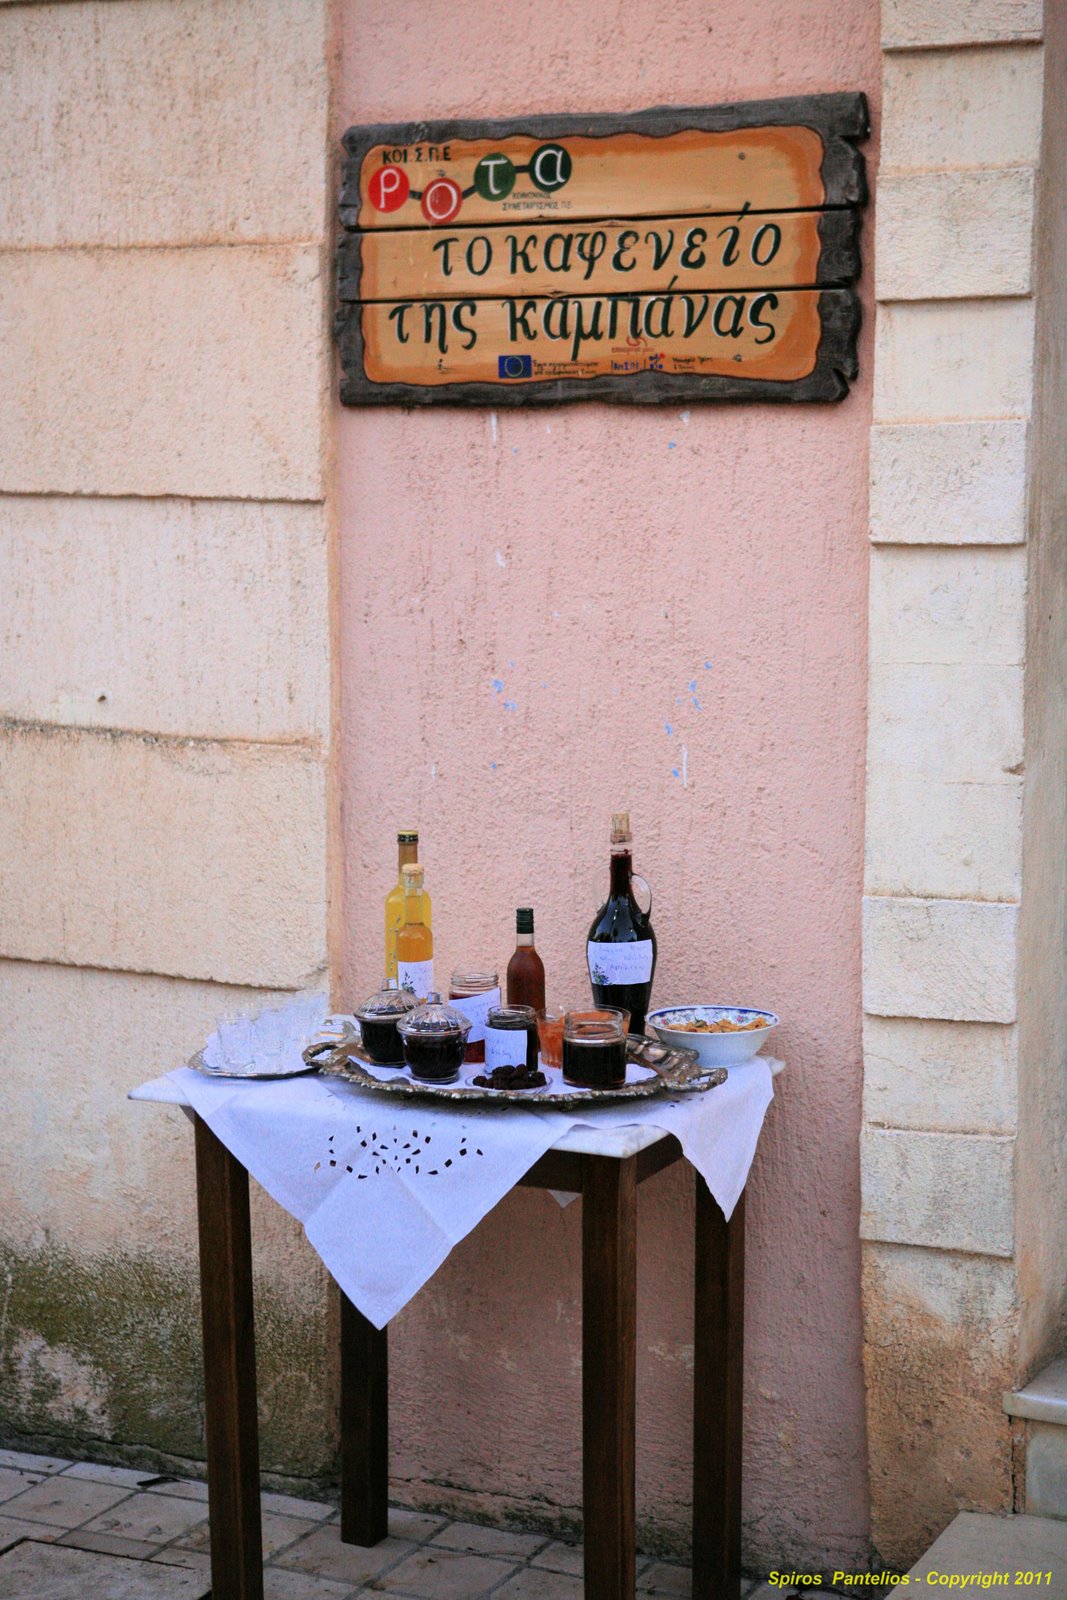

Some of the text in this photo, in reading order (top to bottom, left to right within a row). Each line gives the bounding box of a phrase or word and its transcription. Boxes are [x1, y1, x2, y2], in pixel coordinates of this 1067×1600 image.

[433, 200, 781, 281] το καφενείο
[388, 276, 781, 361] της καμπάνας
